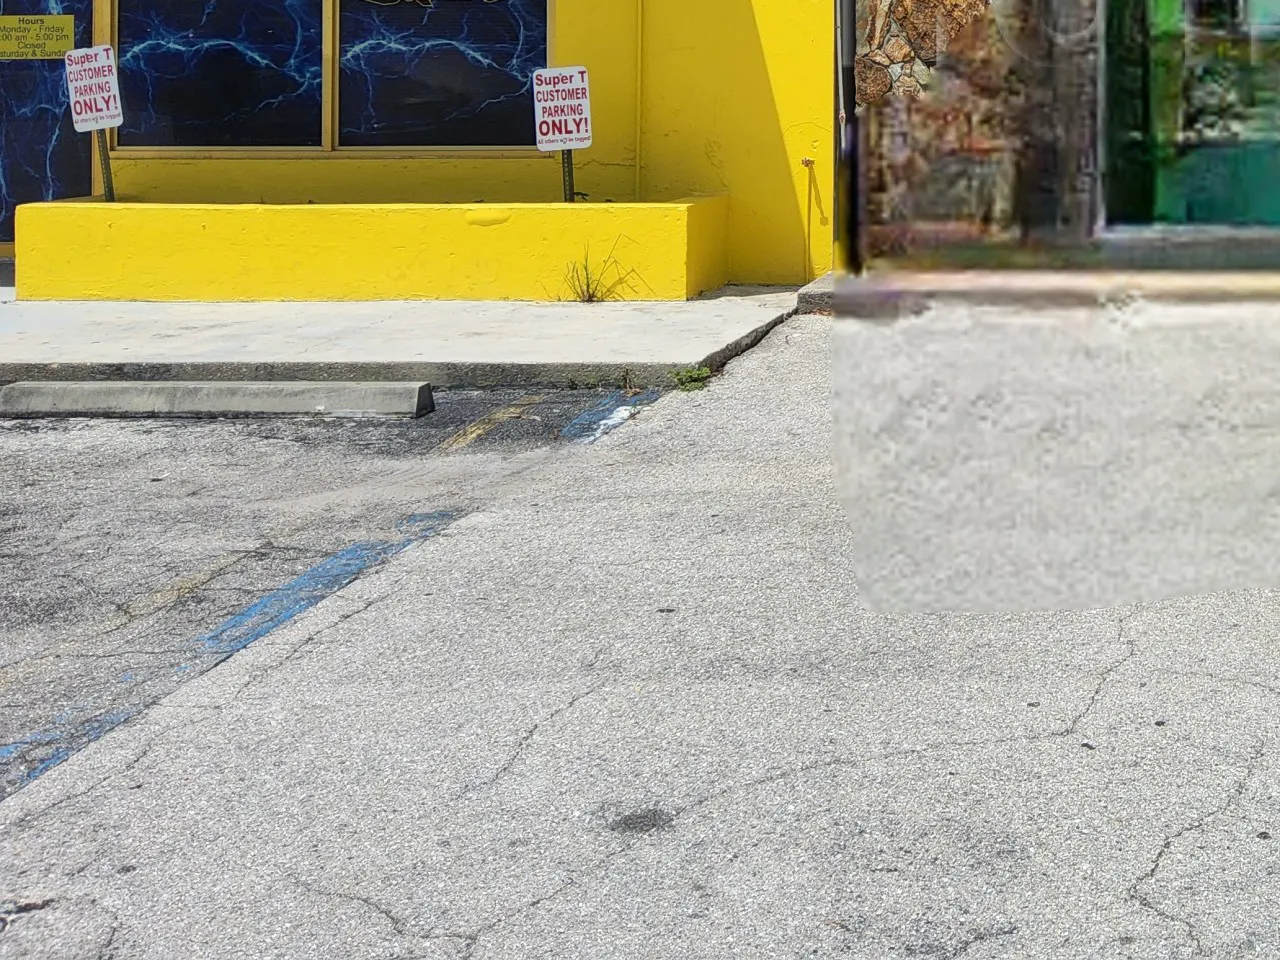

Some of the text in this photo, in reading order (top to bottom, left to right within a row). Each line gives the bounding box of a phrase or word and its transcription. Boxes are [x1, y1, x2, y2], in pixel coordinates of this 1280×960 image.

[18, 17, 45, 25] Hours
[39, 24, 65, 35] Friday
[15, 34, 28, 42] am
[56, 34, 69, 43] pm
[17, 41, 46, 50] Closed
[40, 49, 66, 58] Sunda
[66, 47, 112, 67] Super T
[68, 64, 115, 83] CUSTOMER
[535, 70, 587, 88] Super T
[74, 81, 111, 98] PARKING
[536, 87, 588, 103] CUSTOMER
[73, 94, 119, 117] ONLY!
[541, 103, 584, 119] PARKING
[538, 117, 589, 137] ONLY!
